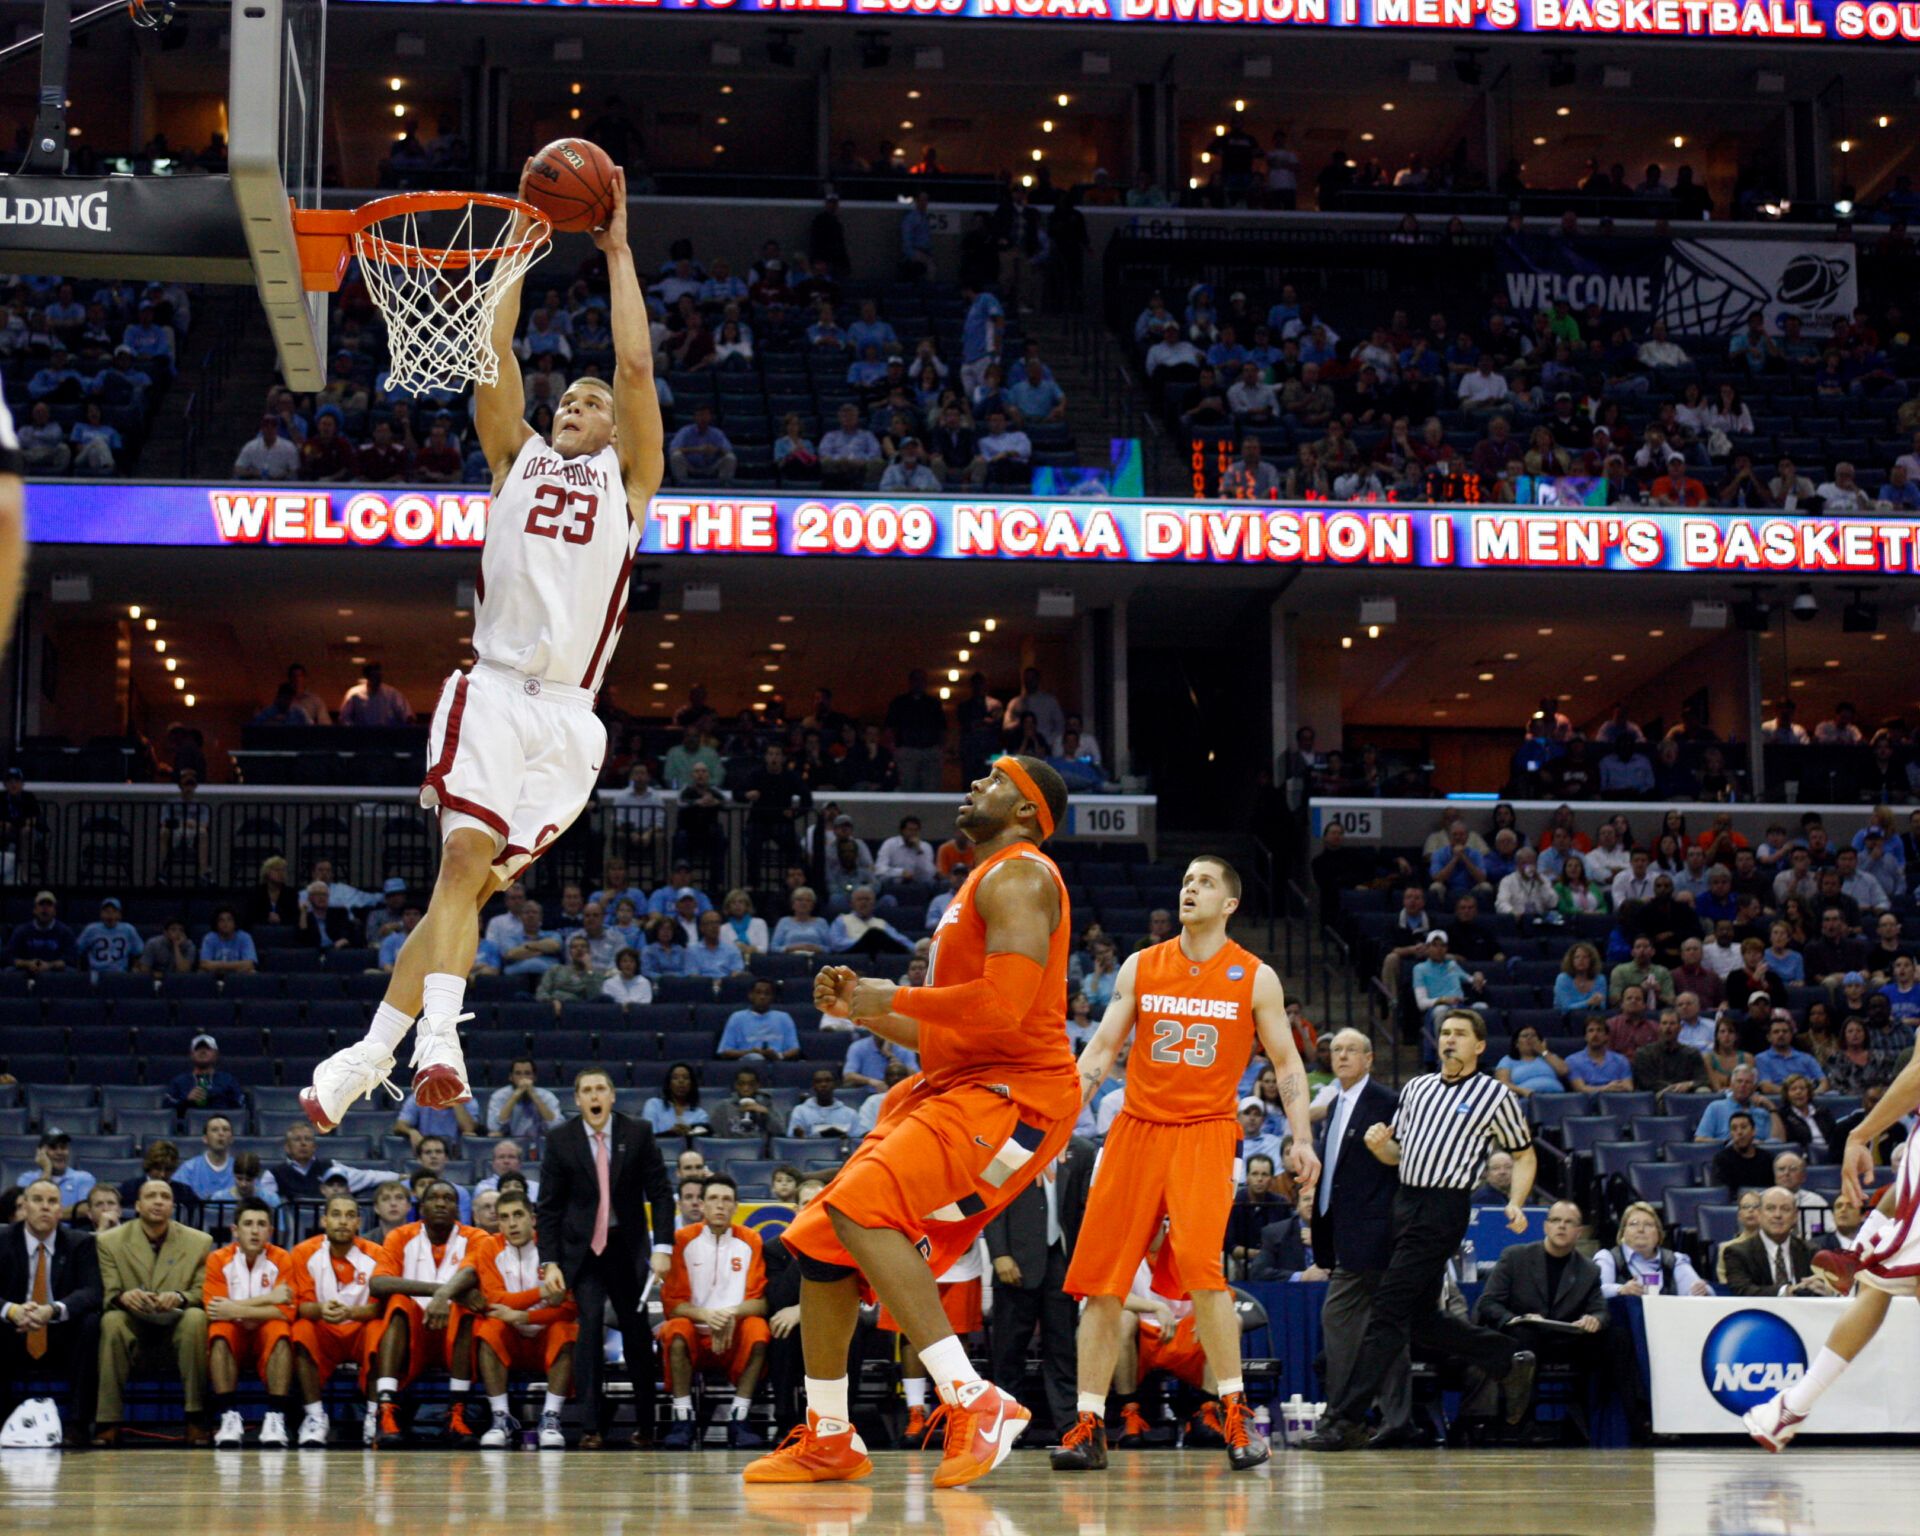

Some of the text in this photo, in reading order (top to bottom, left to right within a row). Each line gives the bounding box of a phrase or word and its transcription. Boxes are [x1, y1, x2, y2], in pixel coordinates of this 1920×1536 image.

[1376, 0, 1517, 26] MEN'S
[1536, 0, 1823, 34] BASKETBALL
[1506, 273, 1652, 312] WELCOME
[524, 484, 598, 545] 23
[214, 496, 1920, 567] WELCOM THE 2009 NCAA DIVISION I MEN'S BASKET
[1087, 809, 1126, 831] 106
[1332, 812, 1371, 834] 105
[95, 937, 126, 961] 23
[1141, 994, 1239, 1020] SYRACUSE
[1152, 1019, 1219, 1068] 23
[1712, 1362, 1806, 1392] NCAA
